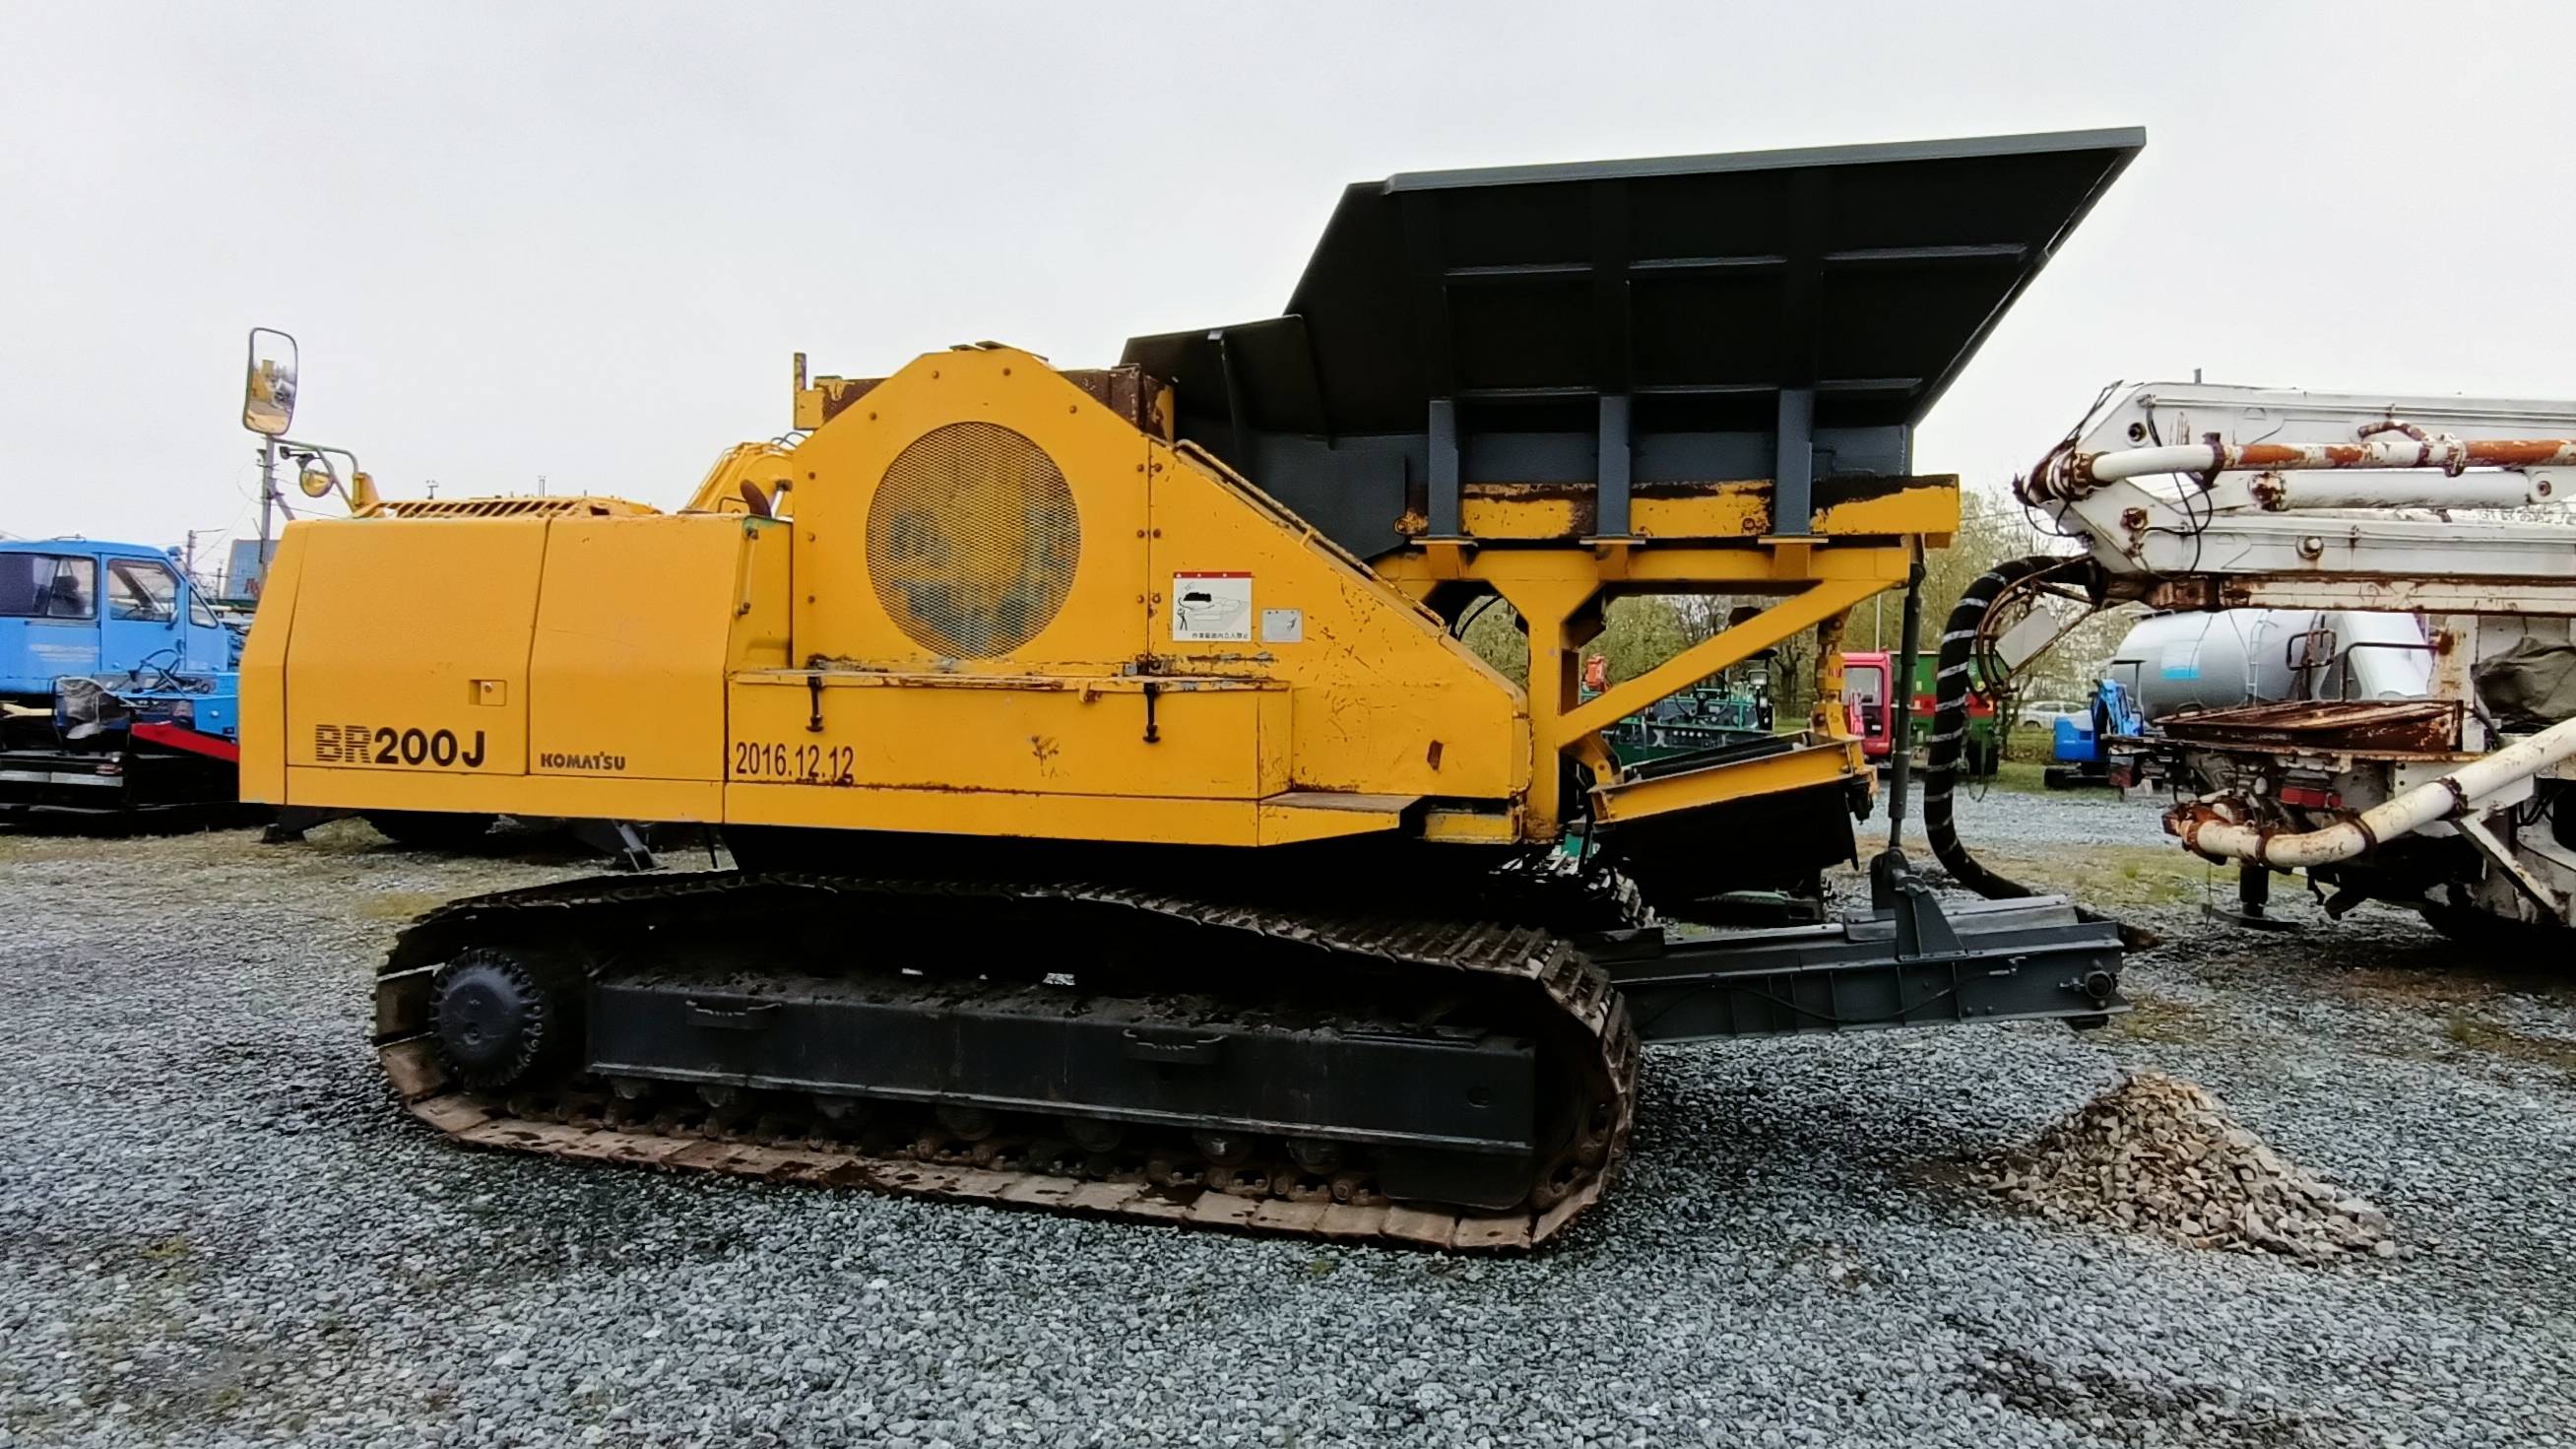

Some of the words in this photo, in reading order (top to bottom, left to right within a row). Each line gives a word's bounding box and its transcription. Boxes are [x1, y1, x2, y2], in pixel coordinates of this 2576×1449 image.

[315, 724, 485, 767] BR200J
[540, 751, 625, 770] KOMATSU
[736, 741, 855, 782] 2016.12.12
